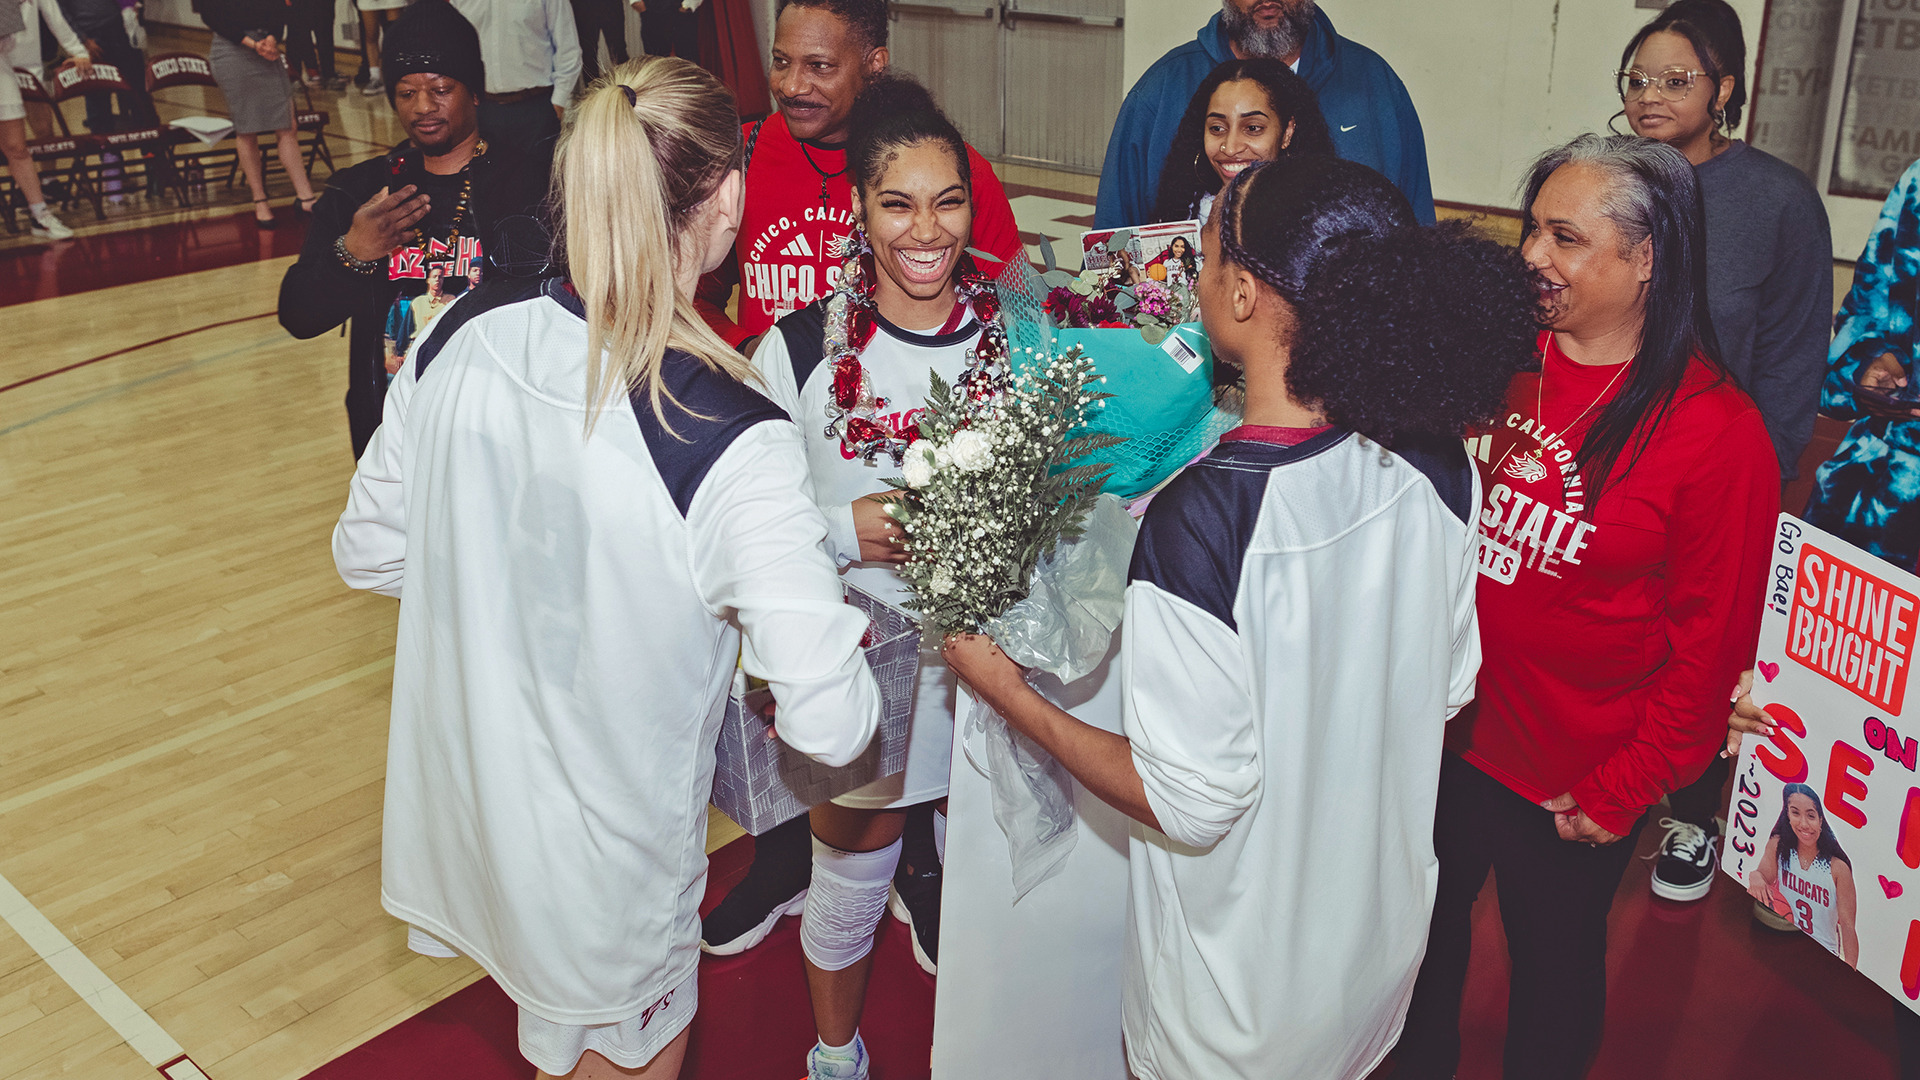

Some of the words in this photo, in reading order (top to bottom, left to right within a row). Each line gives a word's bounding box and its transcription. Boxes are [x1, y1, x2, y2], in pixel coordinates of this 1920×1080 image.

[152, 58, 179, 79] CHICO
[178, 56, 210, 75] STATE
[107, 129, 159, 144] WILDCATS
[750, 216, 797, 262] CHICO,
[743, 262, 816, 303] CHICO
[1506, 412, 1585, 514] CALIFORNIA
[1481, 483, 1598, 566] STATE
[1800, 553, 1915, 655] SHINE
[1791, 605, 1904, 705] BRIGHT
[1863, 716, 1918, 772] ON
[1782, 869, 1830, 908] WILDCATS
[1795, 898, 1814, 935] 3
